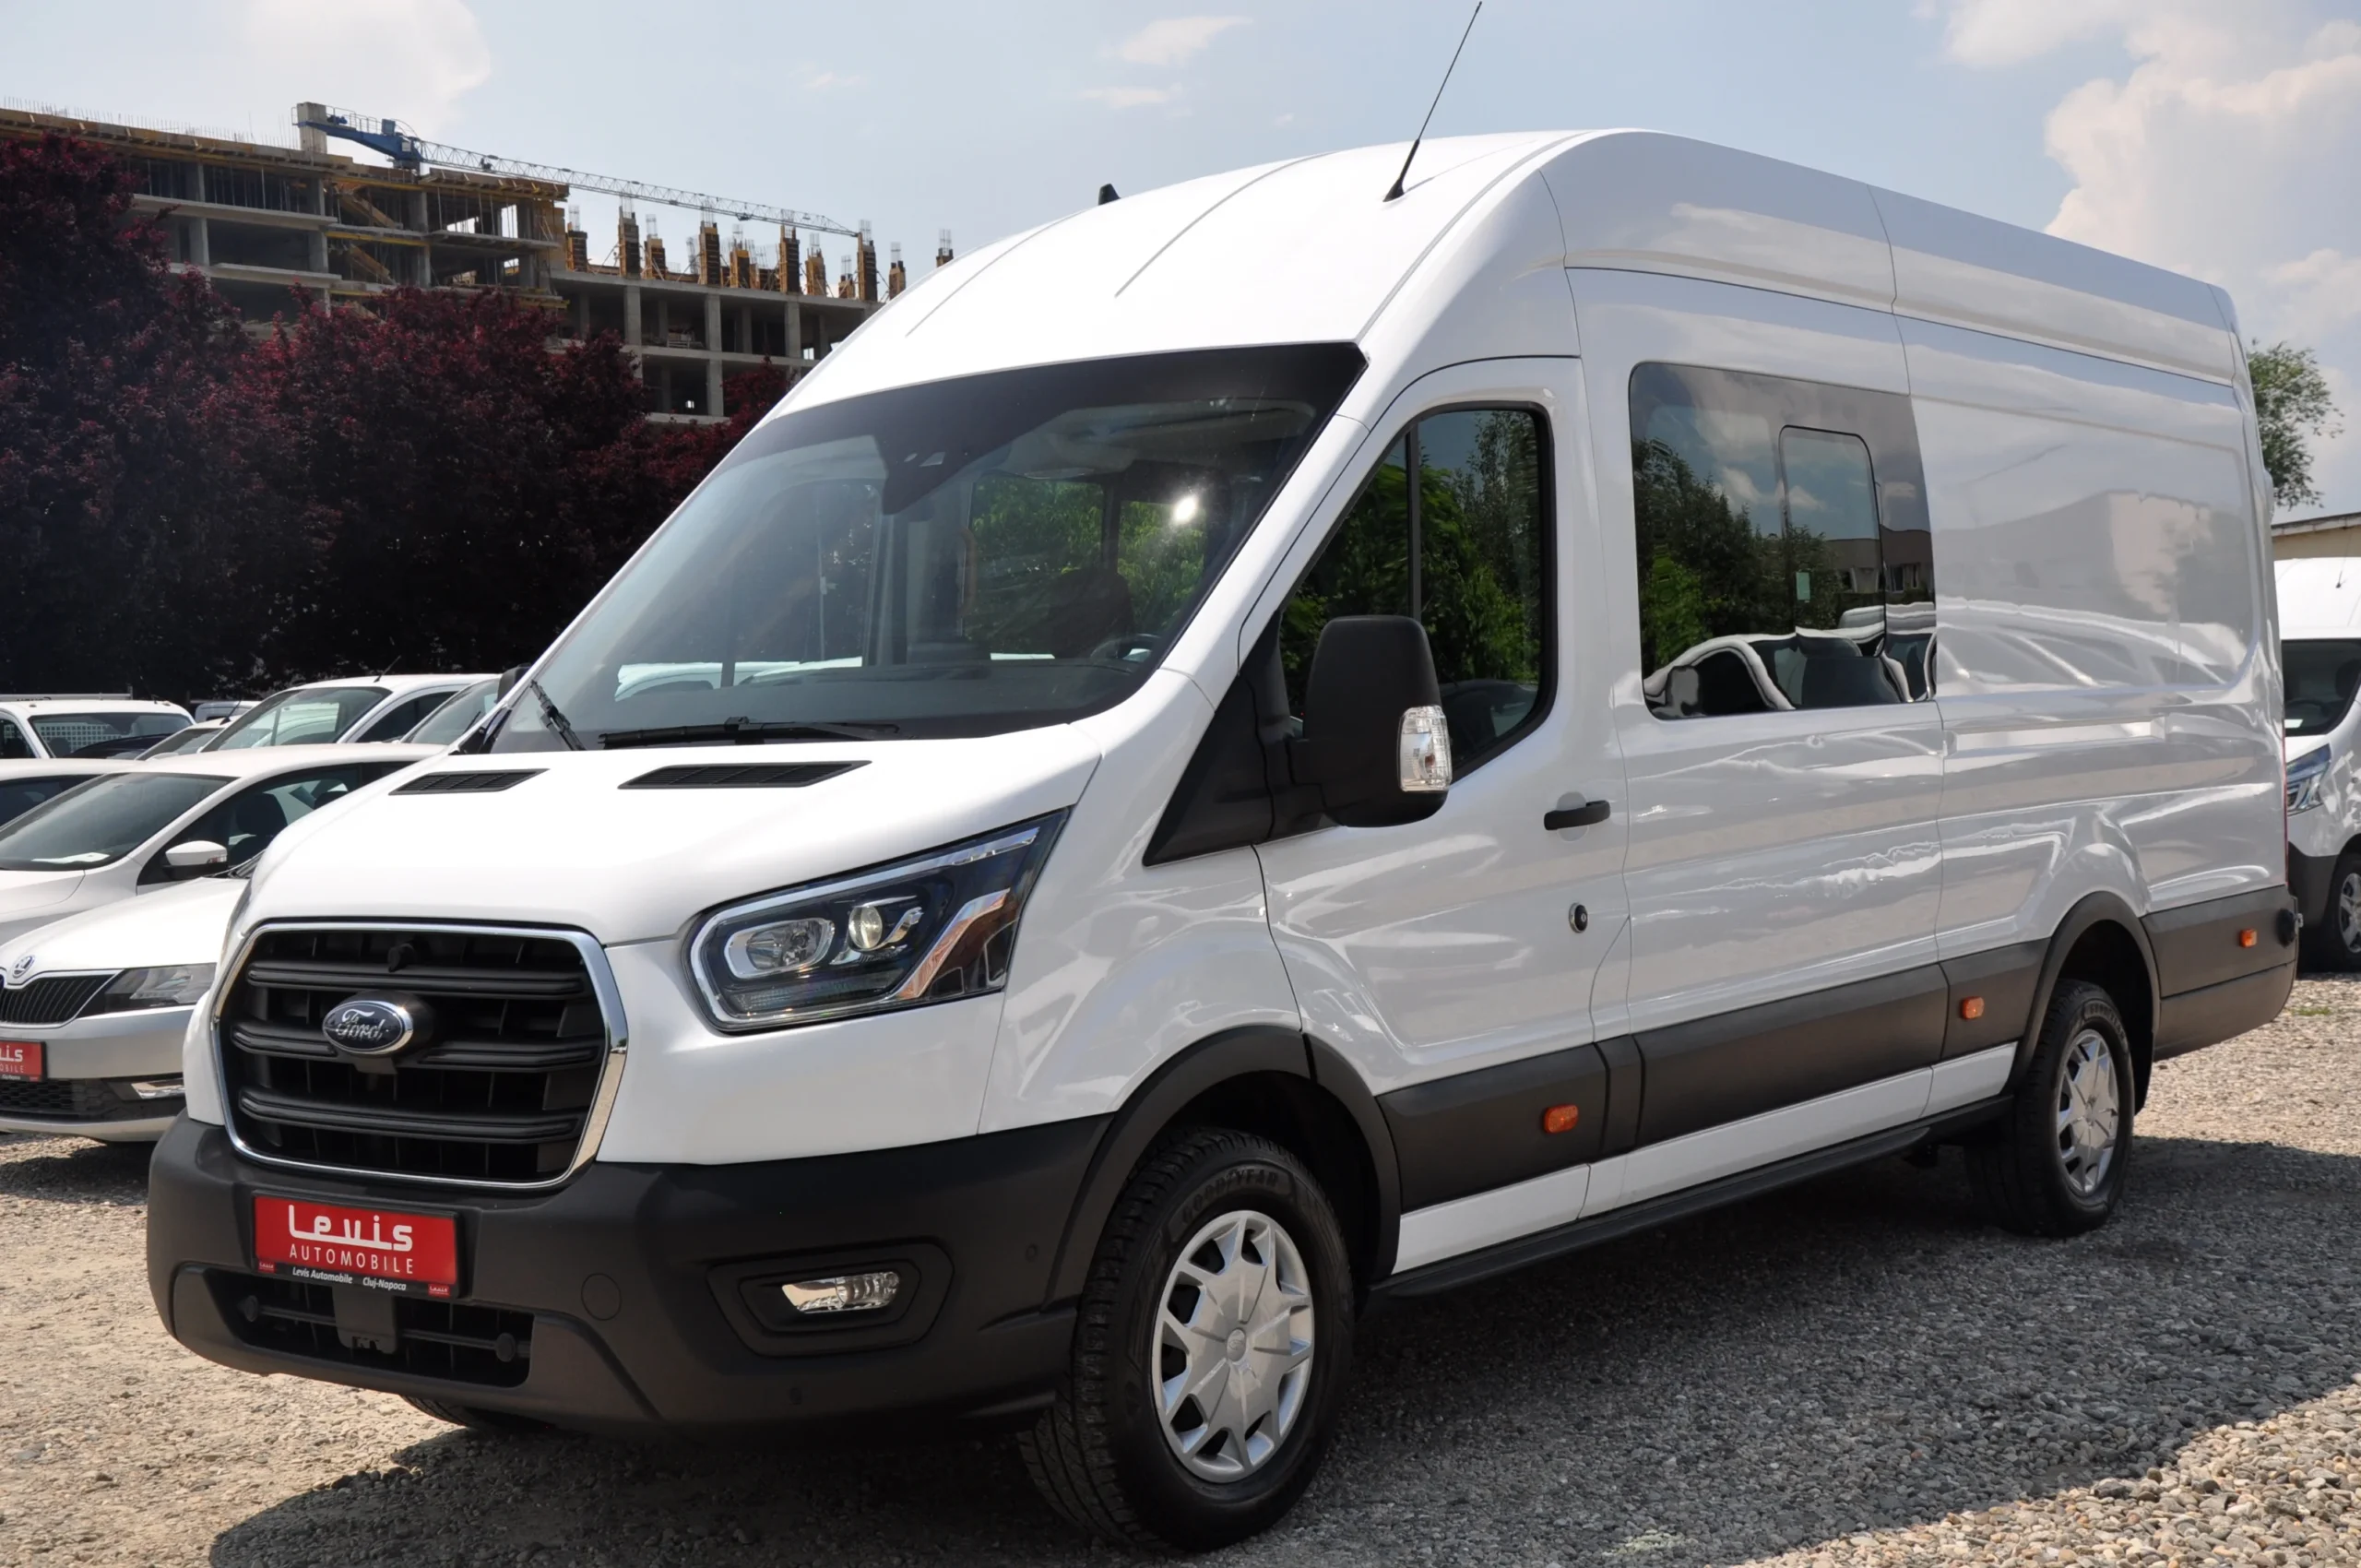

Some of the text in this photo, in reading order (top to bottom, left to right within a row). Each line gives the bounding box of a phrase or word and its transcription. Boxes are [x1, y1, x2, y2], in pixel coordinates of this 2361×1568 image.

[337, 1008, 386, 1041] Ford
[289, 1205, 412, 1252] Levis
[289, 1243, 413, 1275] AUTOMOBILE
[292, 1266, 407, 1291] Levis Automobile Cluj-Napoca
